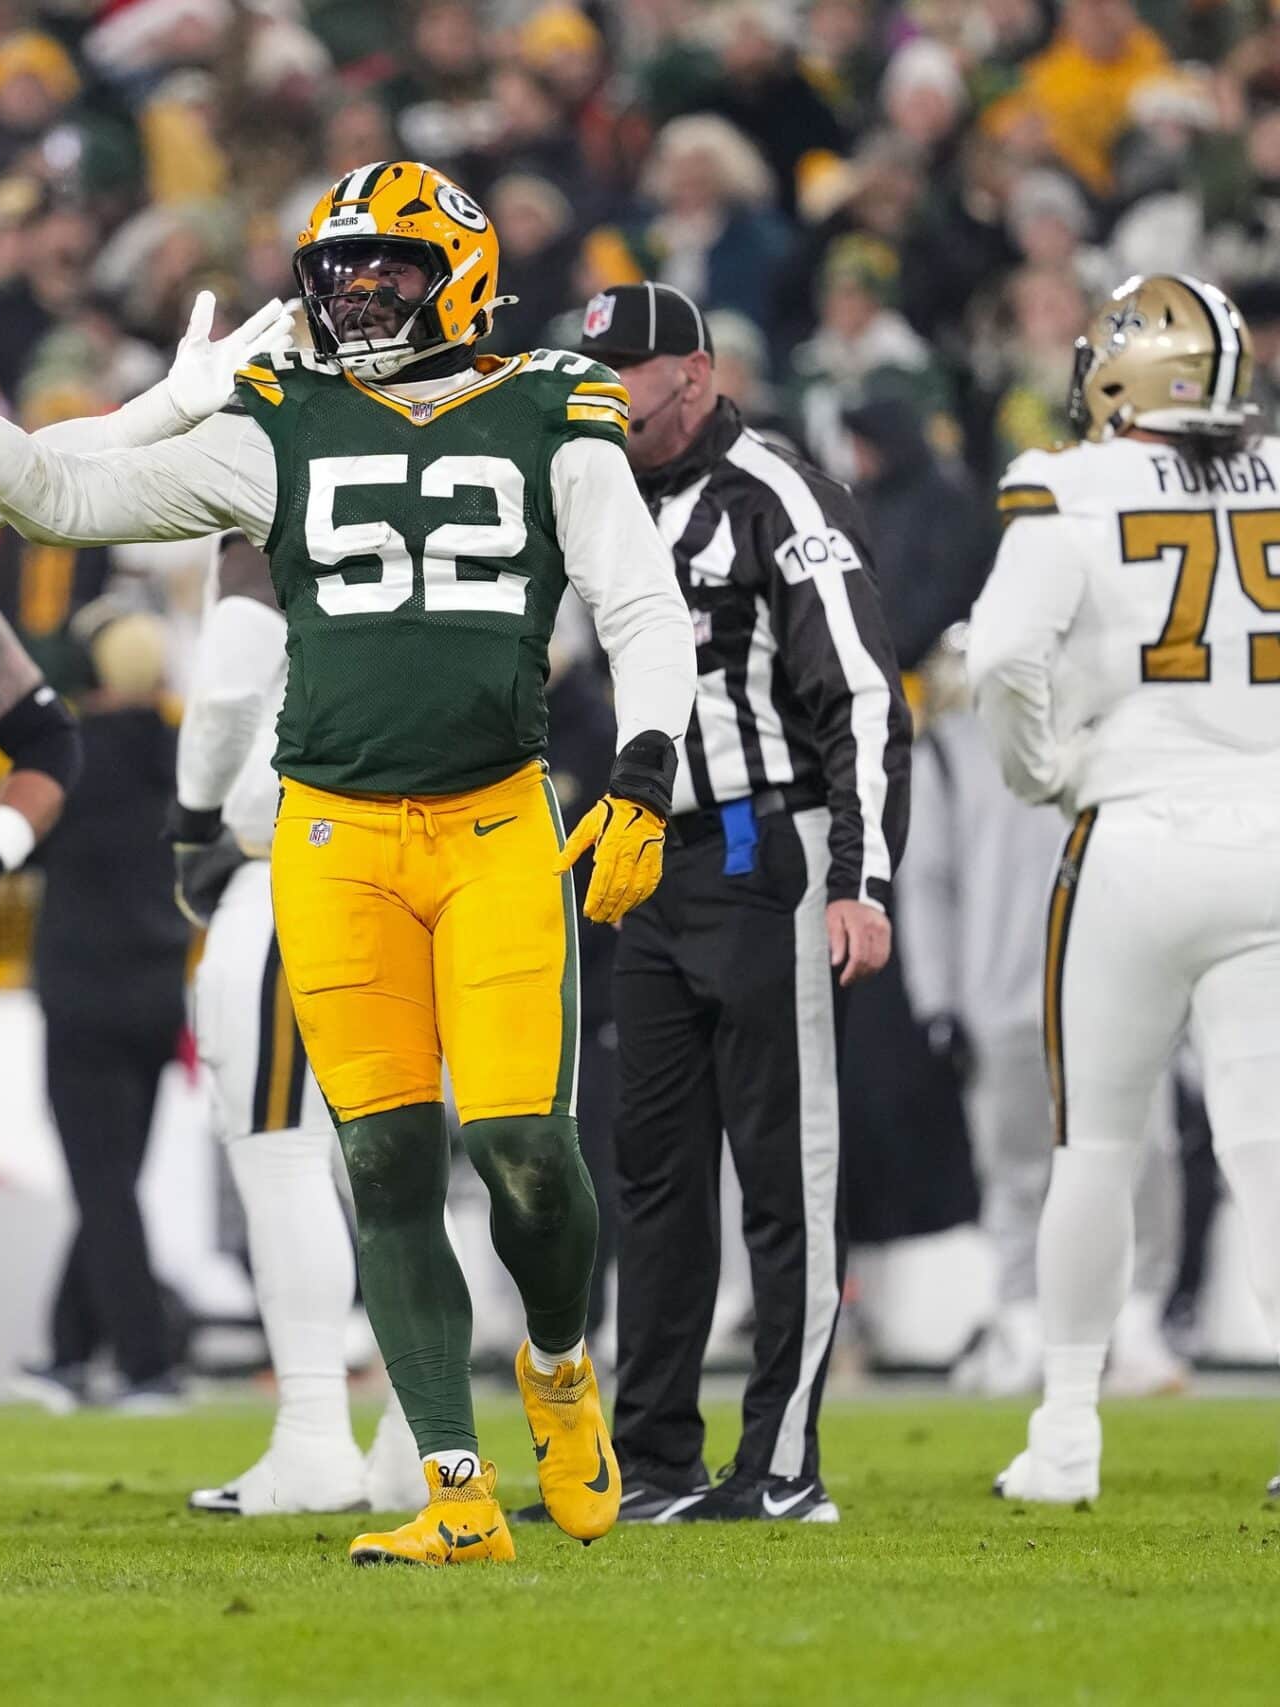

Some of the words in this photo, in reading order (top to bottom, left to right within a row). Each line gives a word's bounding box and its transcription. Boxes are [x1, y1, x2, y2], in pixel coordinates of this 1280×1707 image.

[329, 216, 358, 228] PACKERS
[305, 454, 531, 616] 52
[1117, 508, 1280, 685] 75
